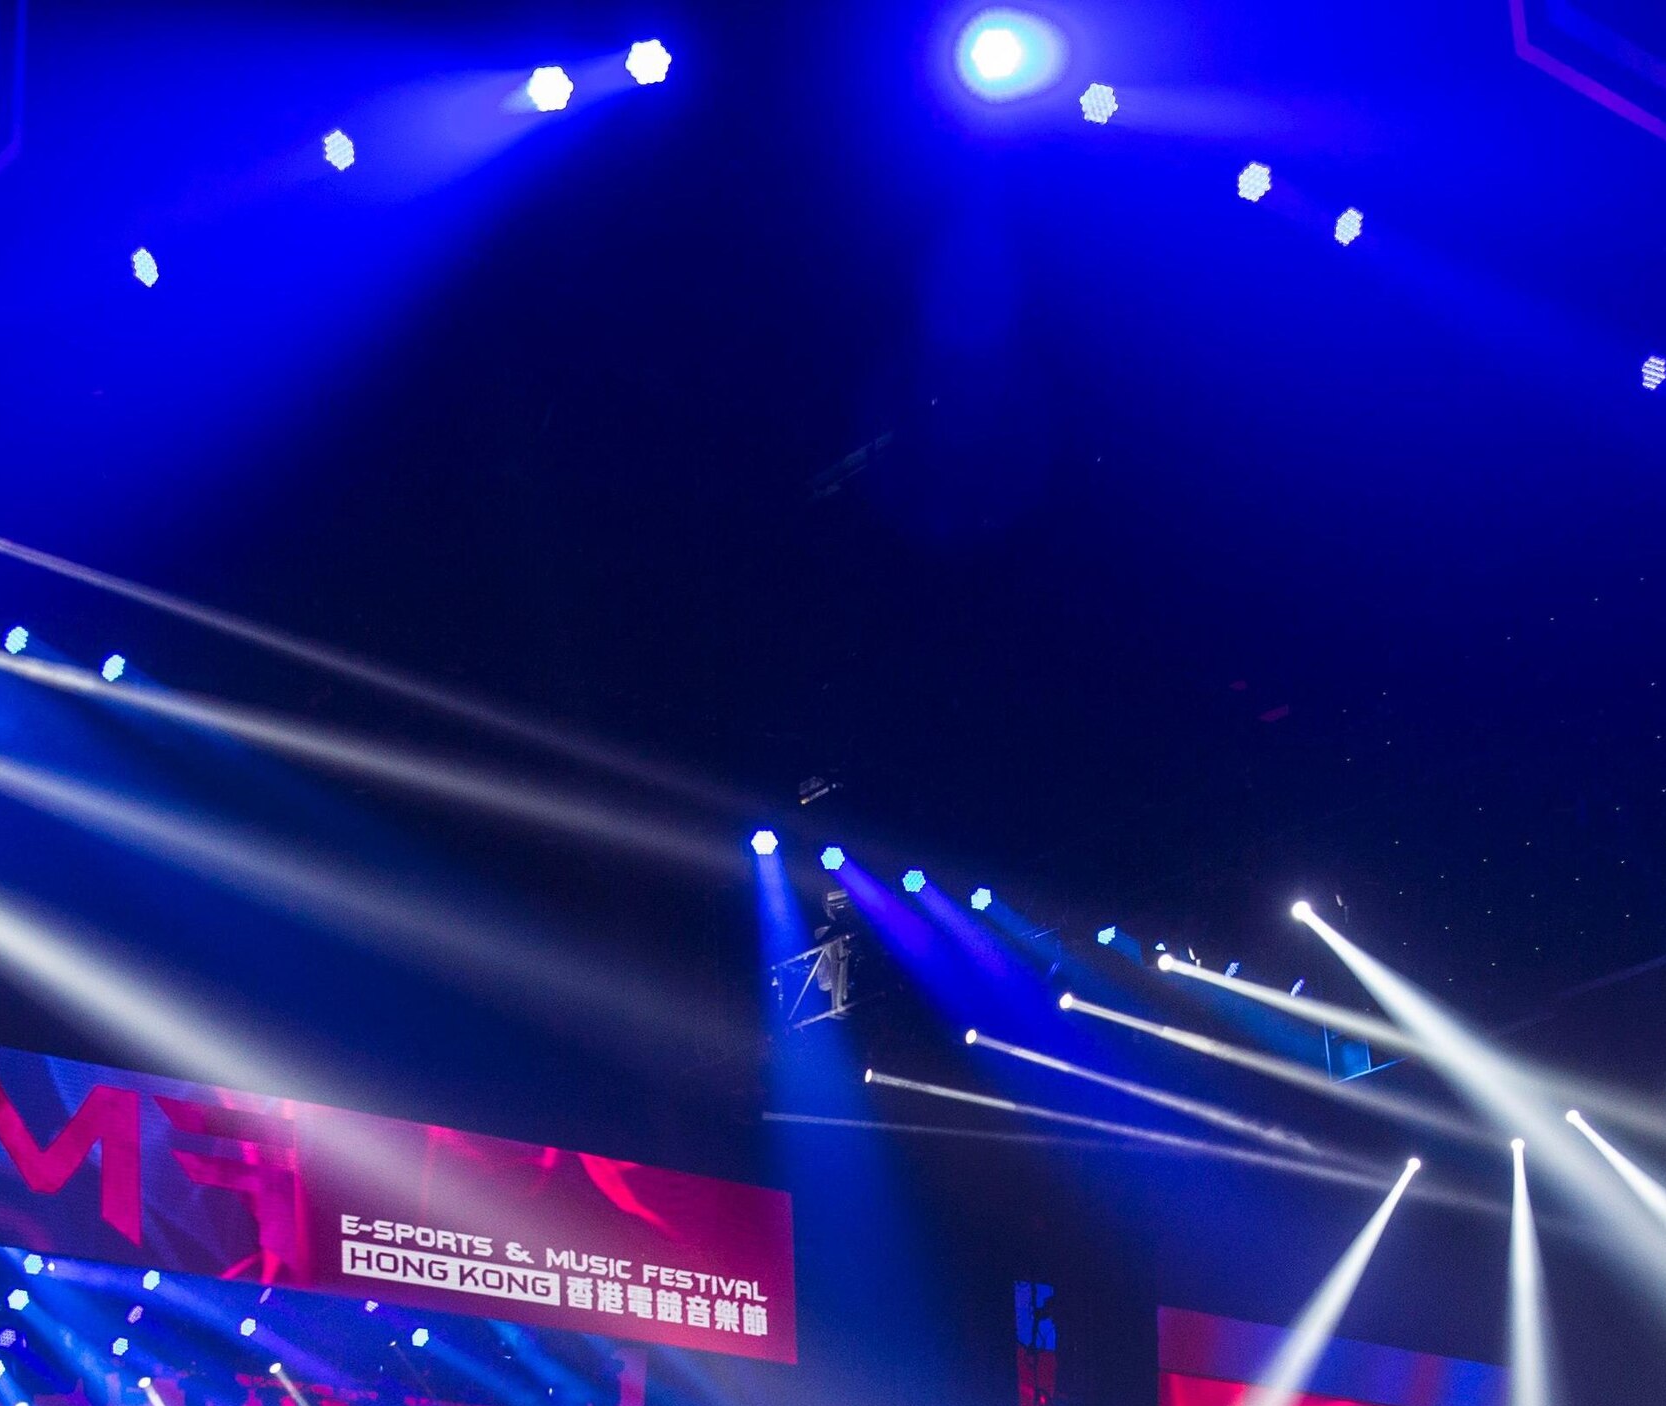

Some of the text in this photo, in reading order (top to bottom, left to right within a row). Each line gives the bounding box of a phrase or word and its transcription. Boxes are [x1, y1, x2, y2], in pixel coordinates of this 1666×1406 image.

[341, 1214, 769, 1302] E-SPORTS & MUSIC FESTIVAL
[349, 1246, 553, 1298] HONG KONG
[566, 1276, 768, 1337] 香港電競音樂節
